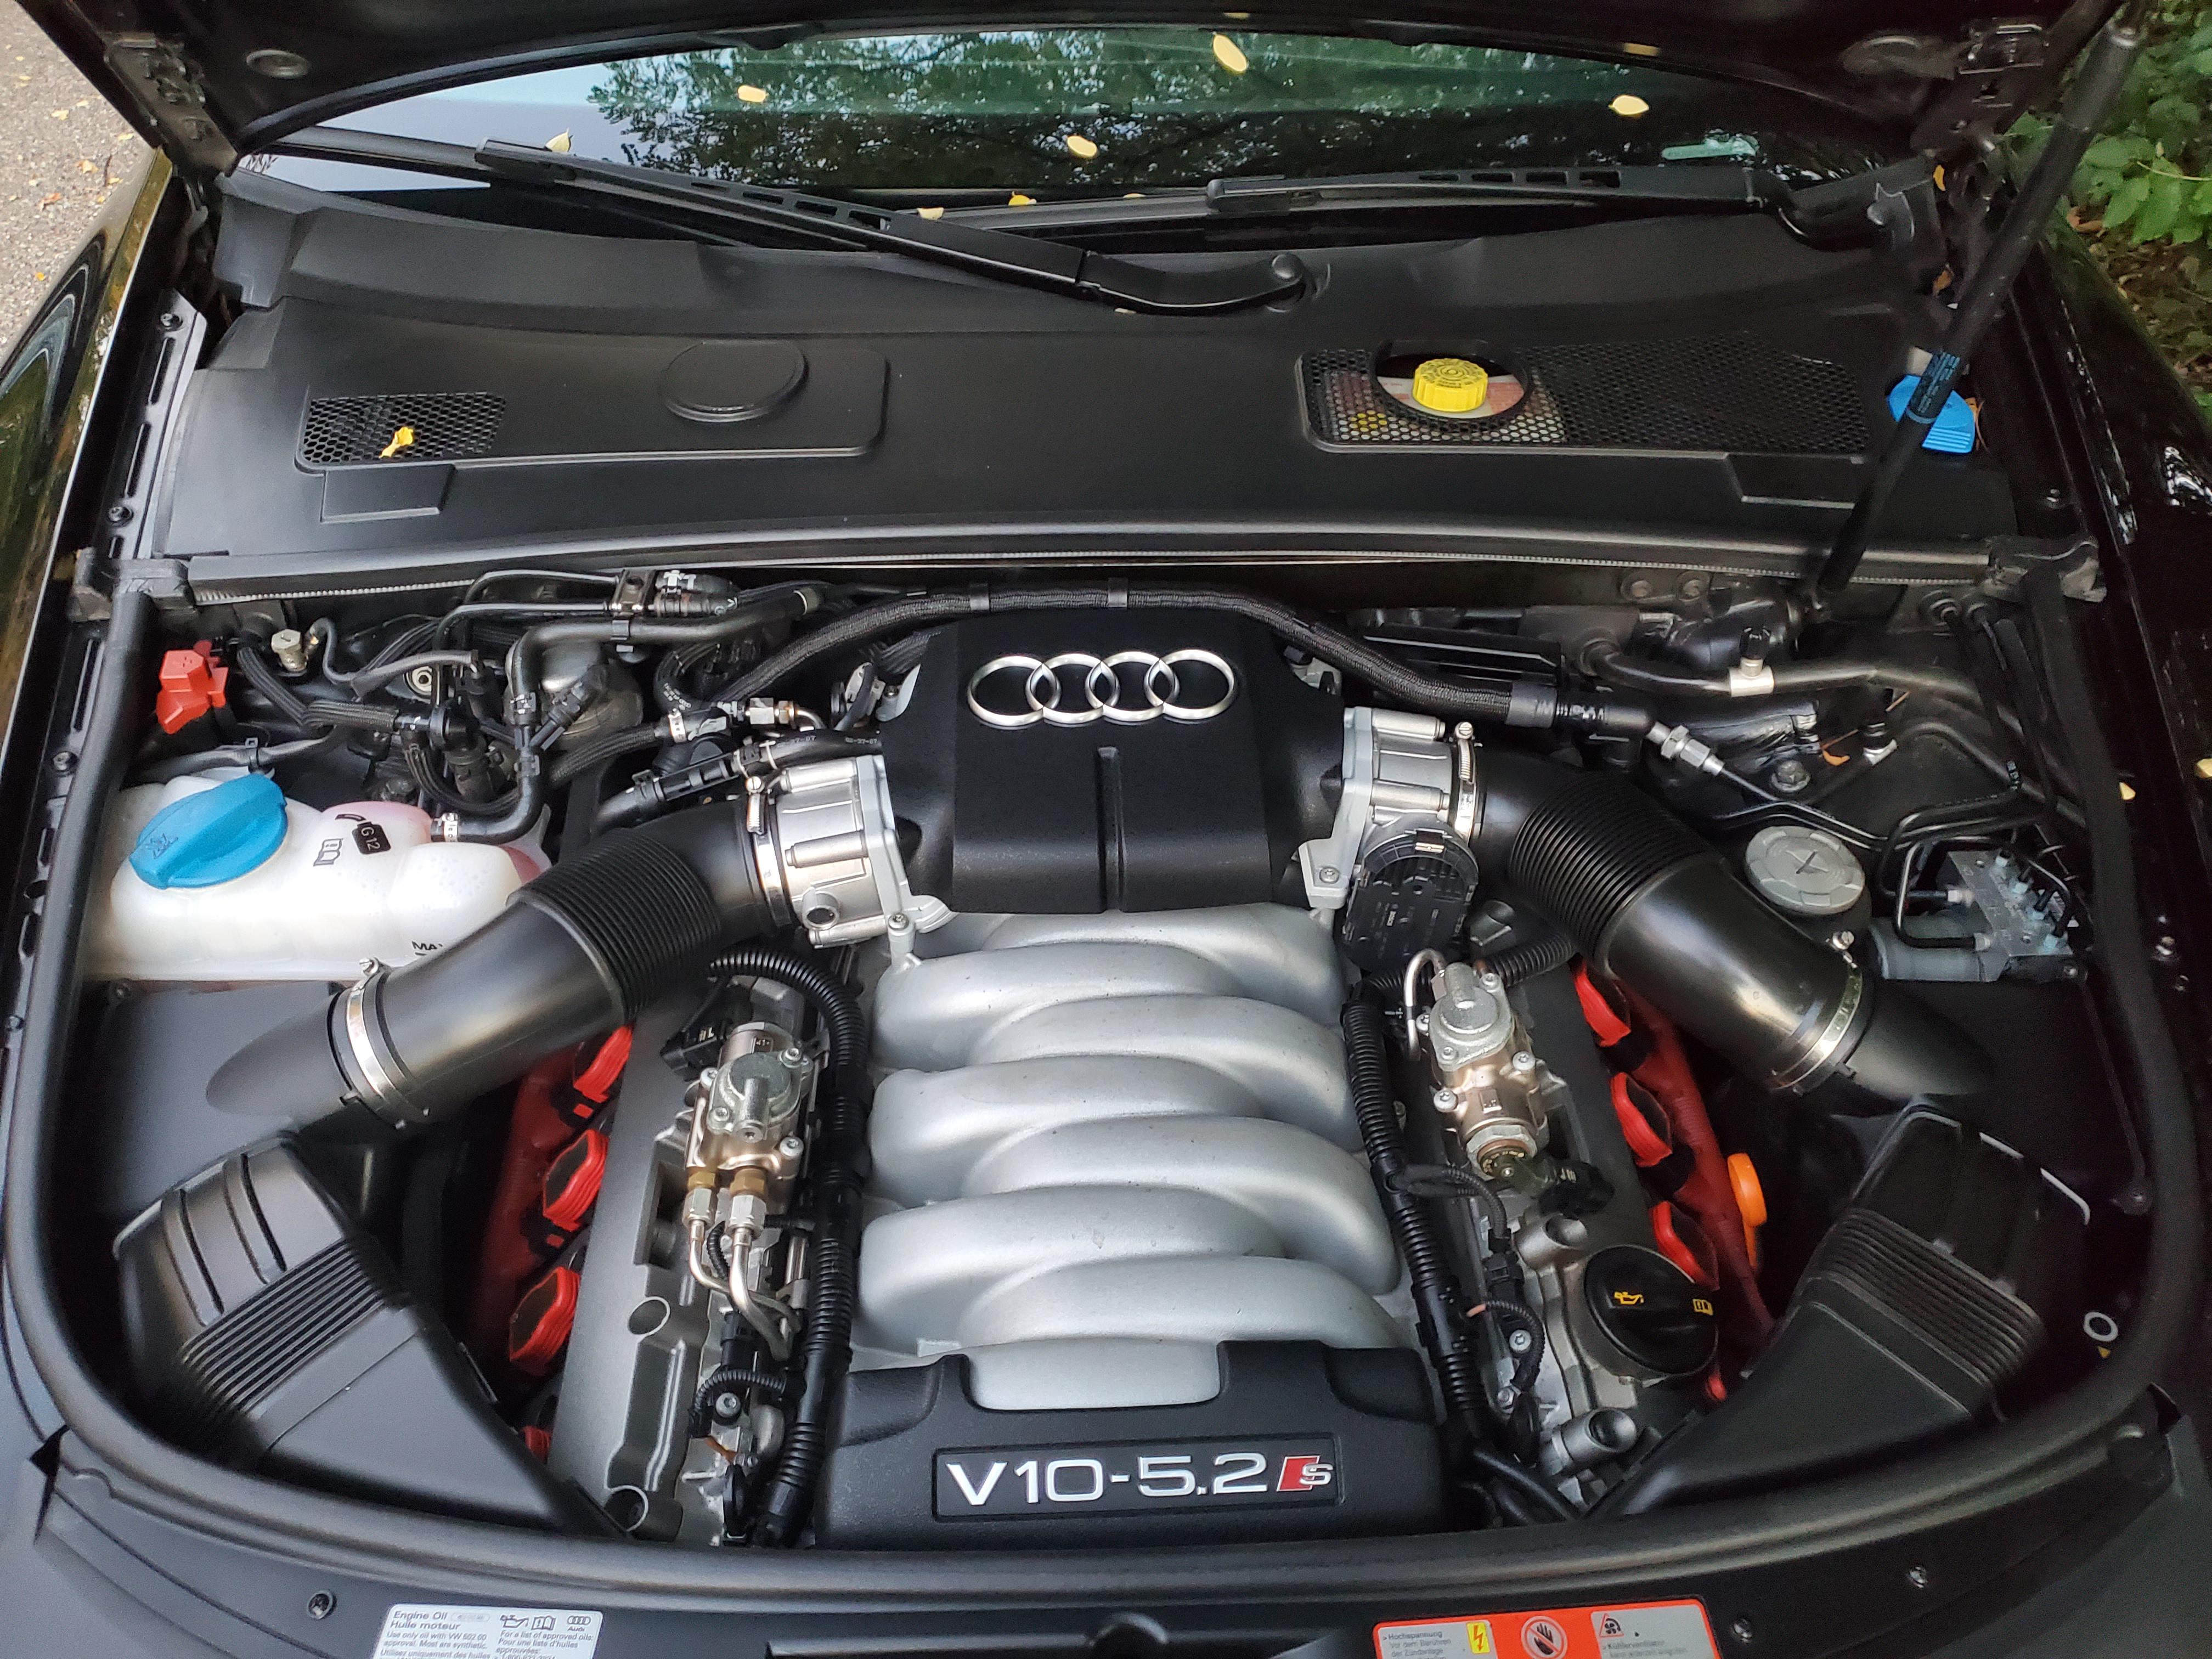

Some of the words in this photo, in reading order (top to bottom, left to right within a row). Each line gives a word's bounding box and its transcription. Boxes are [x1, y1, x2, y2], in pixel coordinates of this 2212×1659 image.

[946, 1452, 1268, 1506] V10-5.2
[394, 1611, 430, 1621] Engine
[433, 1611, 448, 1620] Oil
[390, 1620, 417, 1628] Huile
[420, 1622, 461, 1630] moteur
[402, 1632, 419, 1640] only
[453, 1650, 466, 1658] des
